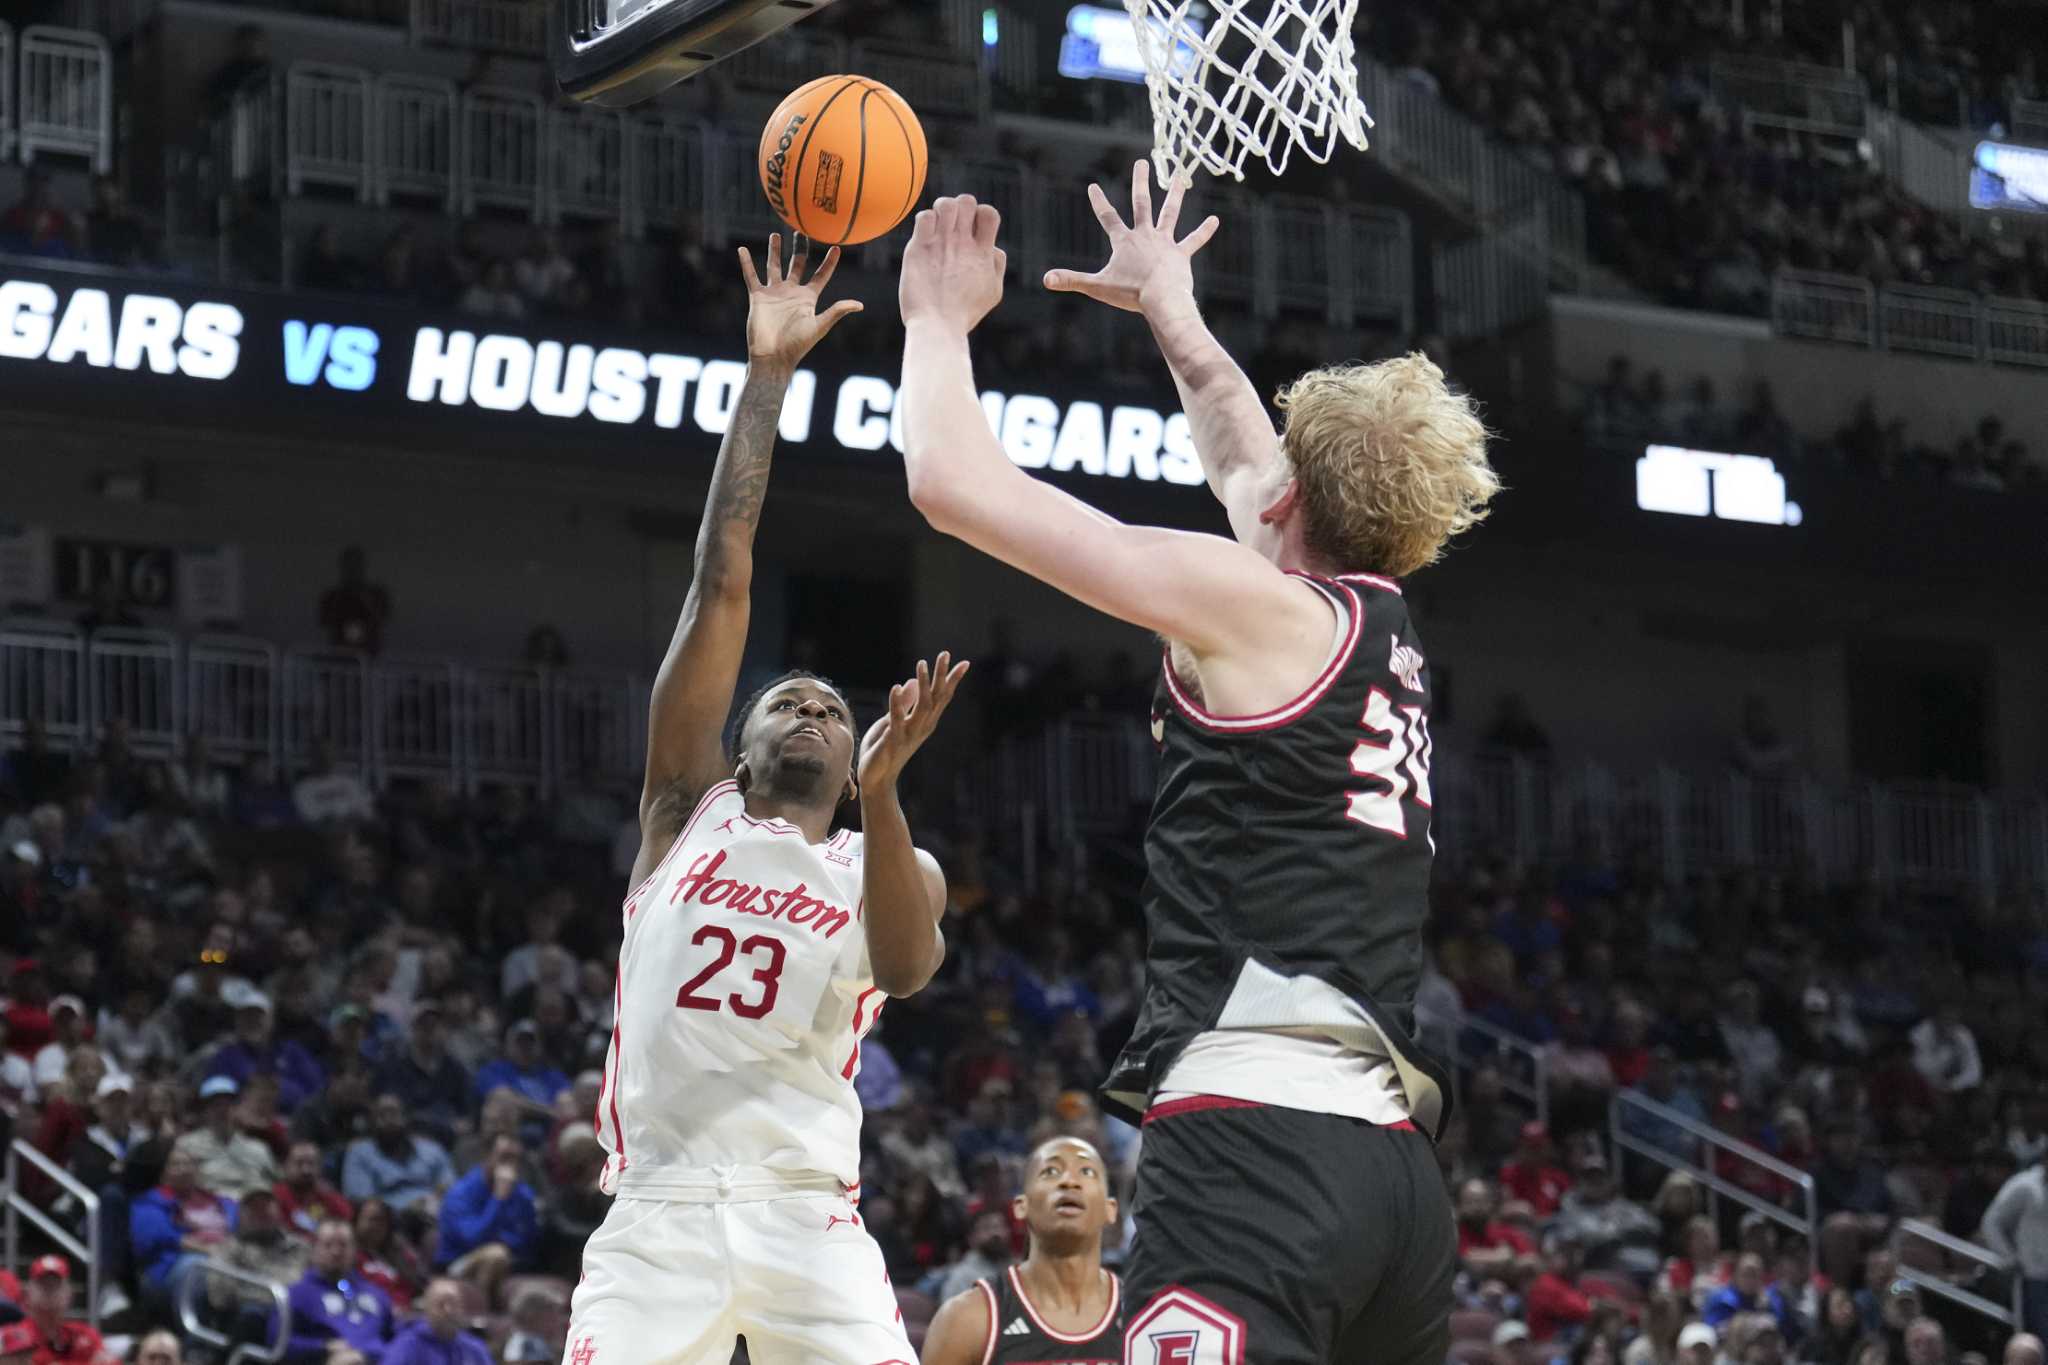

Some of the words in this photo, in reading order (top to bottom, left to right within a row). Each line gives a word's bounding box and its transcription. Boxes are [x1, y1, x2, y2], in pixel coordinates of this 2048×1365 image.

[0, 280, 244, 380] GARS
[283, 320, 380, 391] VS
[833, 375, 1206, 487] CGARS
[670, 849, 850, 939] Houston
[676, 924, 787, 1020] 23
